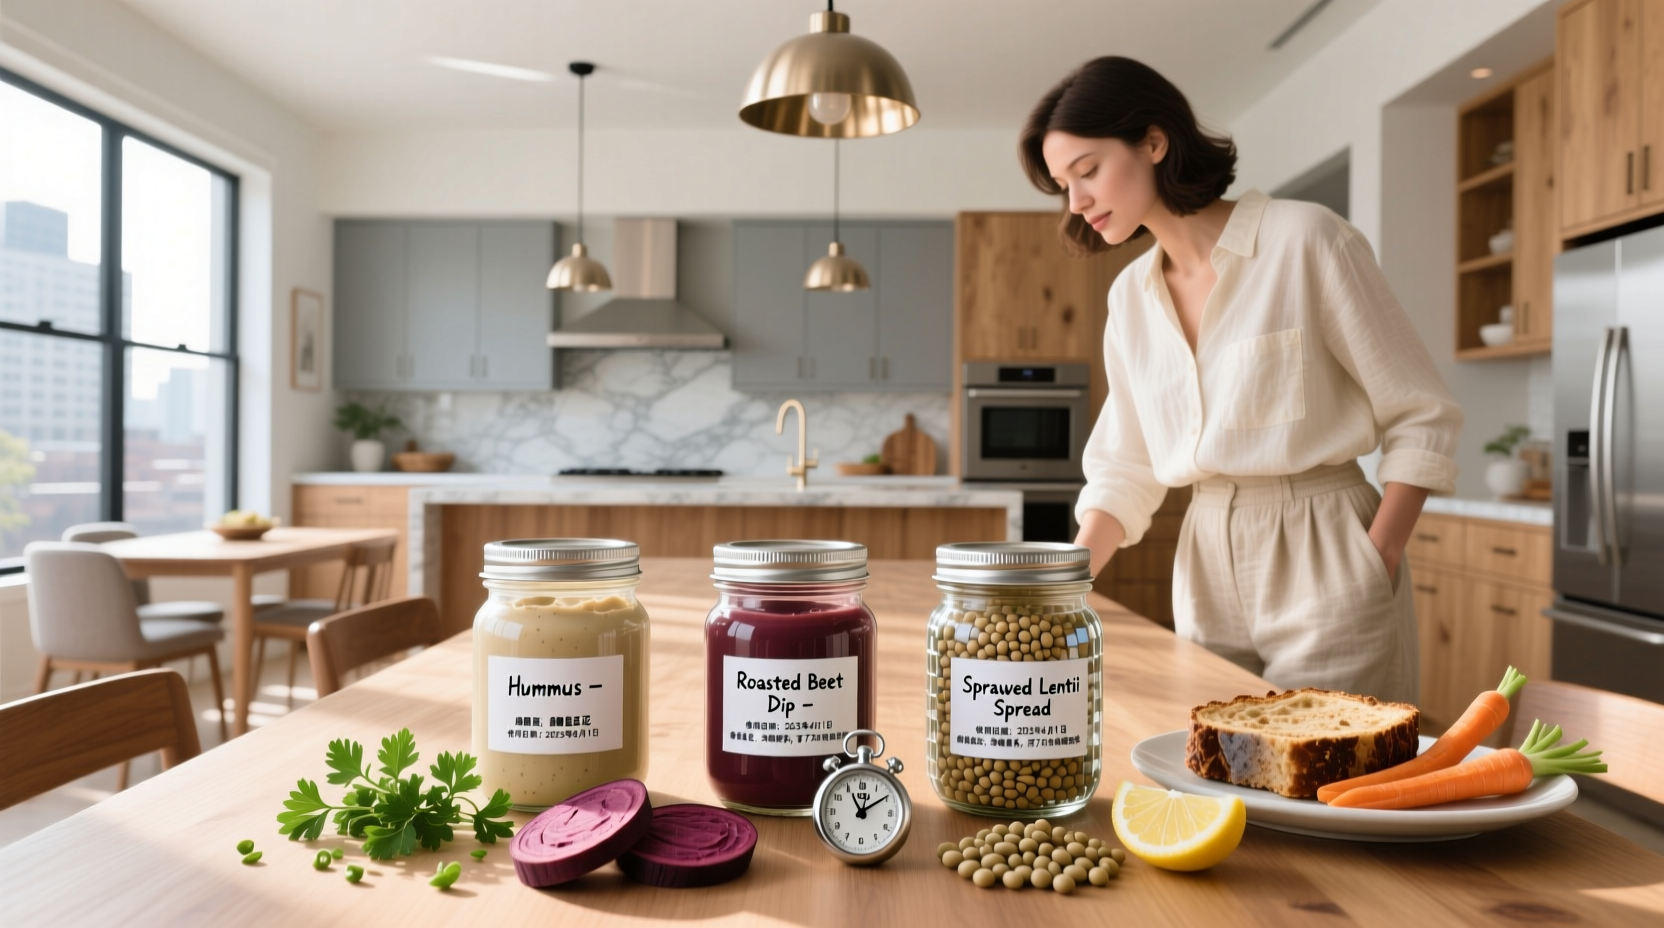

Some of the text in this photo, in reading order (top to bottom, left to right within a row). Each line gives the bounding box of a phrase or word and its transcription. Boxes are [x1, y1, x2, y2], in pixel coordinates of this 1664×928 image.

[508, 674, 582, 698] Hummus
[737, 671, 844, 691] Roasted Beet
[767, 694, 796, 719] Dip
[993, 698, 1052, 723] Spread
